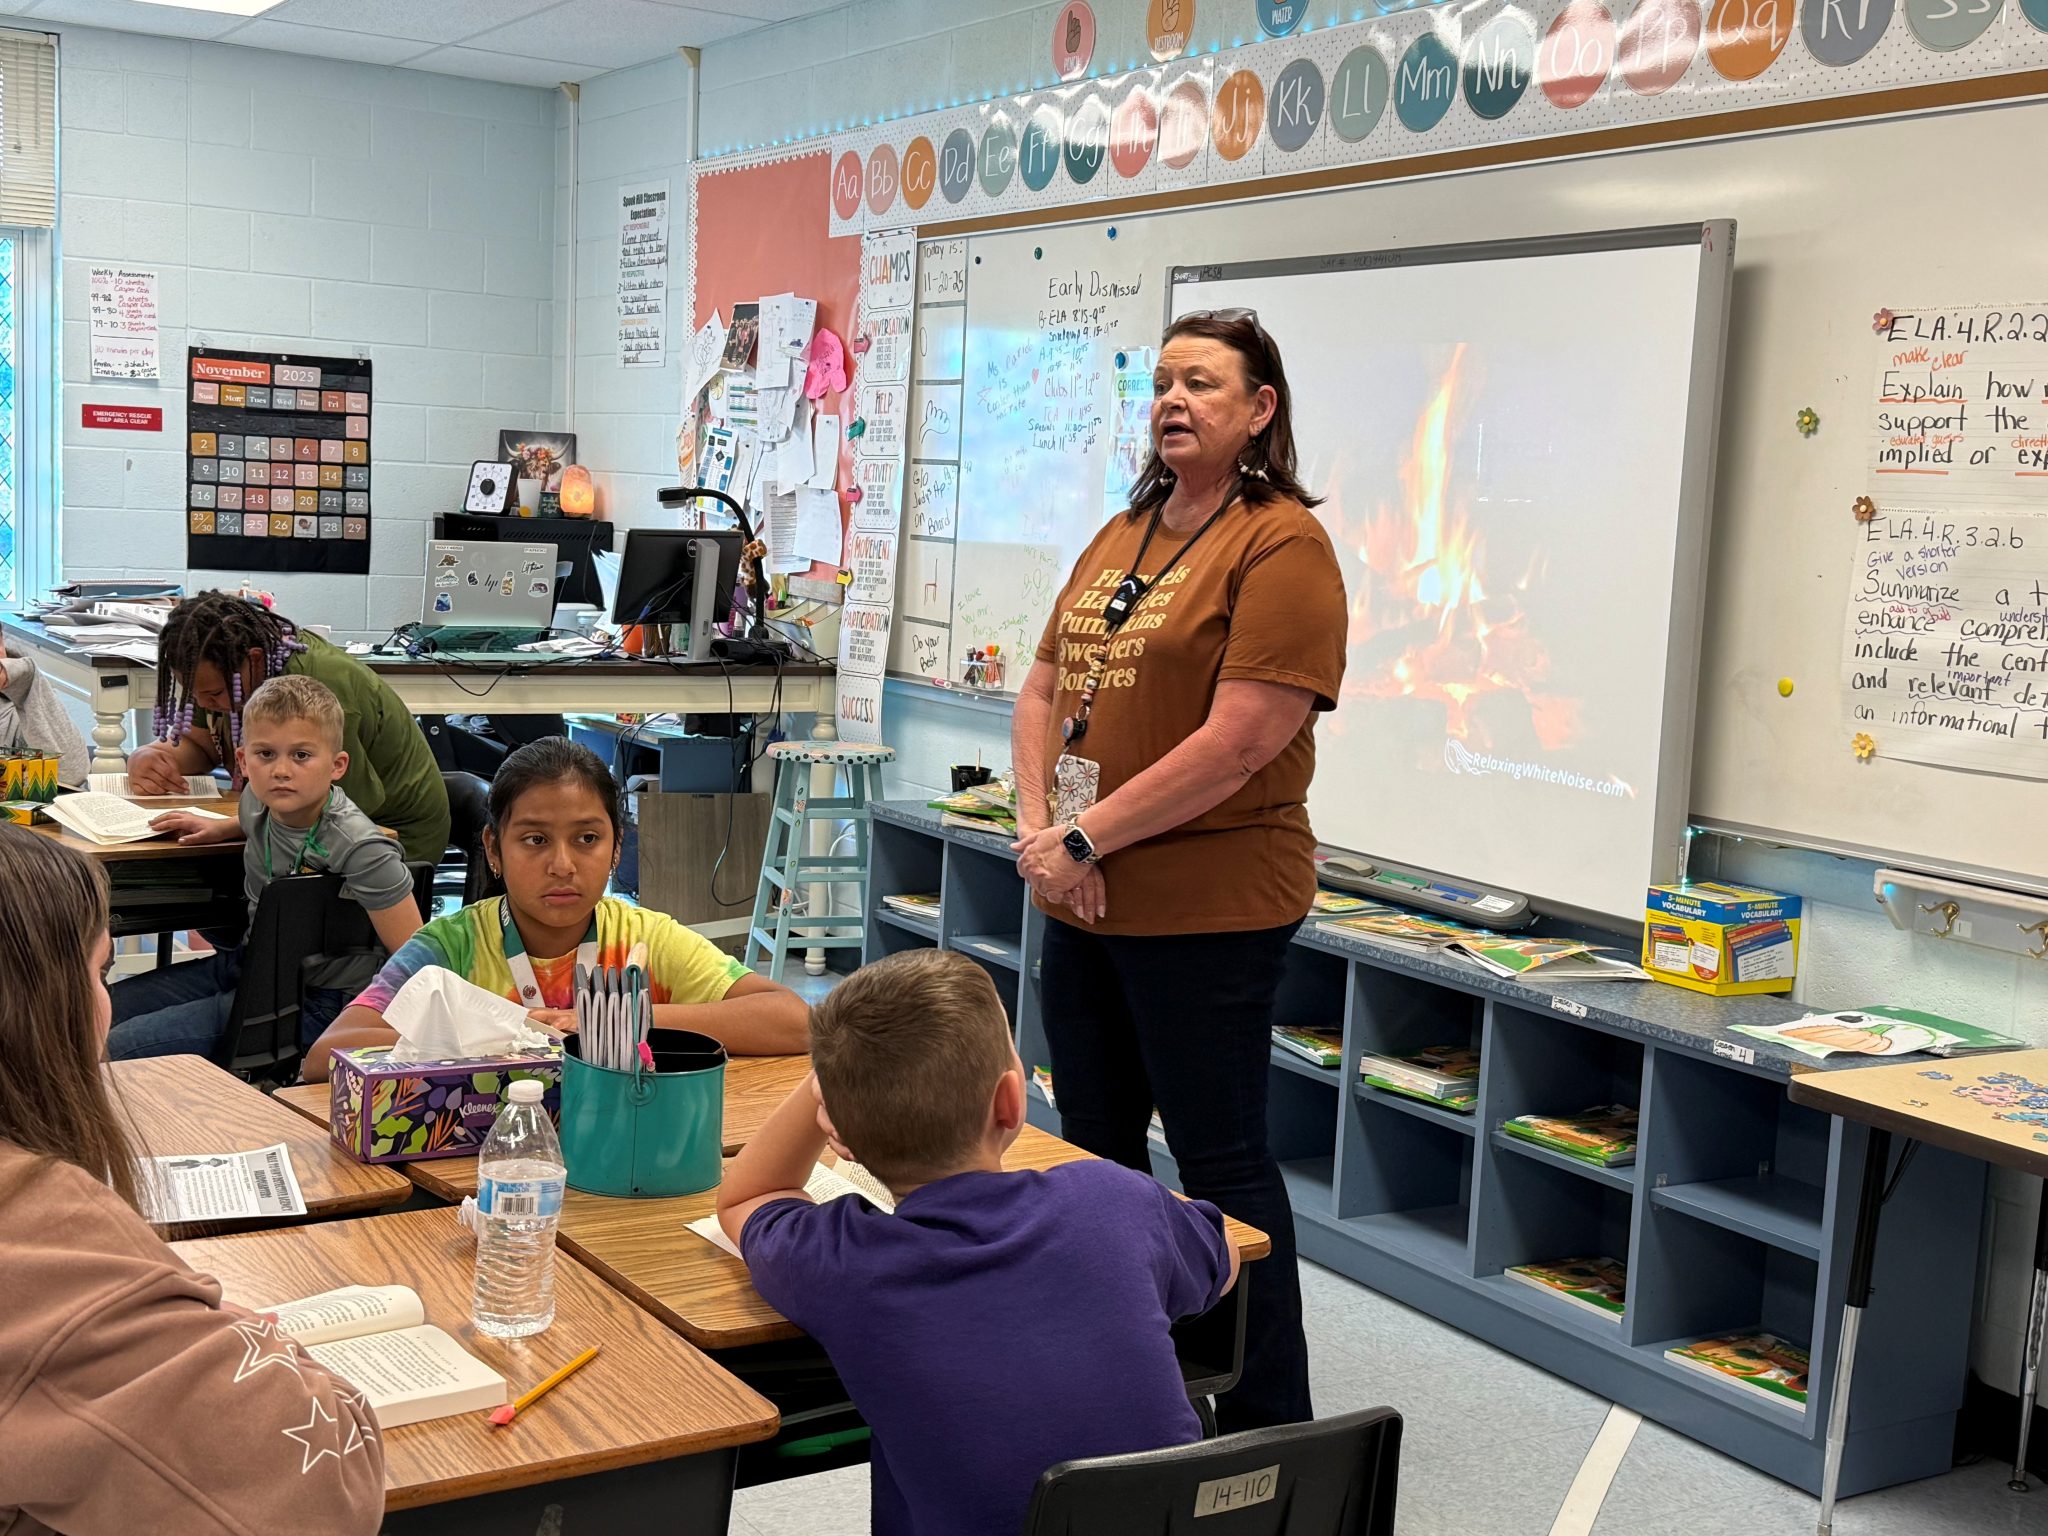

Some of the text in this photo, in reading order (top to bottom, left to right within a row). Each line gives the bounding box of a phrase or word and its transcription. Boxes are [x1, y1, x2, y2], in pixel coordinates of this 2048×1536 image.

[1272, 7, 1292, 25] WATER
[1154, 32, 1184, 52] RESTROOM
[836, 167, 859, 200] Aa
[871, 160, 894, 199] Bb
[906, 152, 931, 193] Cc
[944, 144, 969, 185] Dd
[985, 136, 1010, 177] Ee
[1028, 128, 1052, 174] Ff
[1069, 117, 1101, 167] Gg
[1223, 88, 1251, 143] Jj
[1277, 76, 1315, 128] Kk
[1343, 63, 1371, 119] Ll
[1400, 56, 1450, 104] Mm
[1476, 35, 1521, 95] Nn
[1551, 24, 1601, 79] Oo
[1636, 7, 1688, 74] Pp
[1718, 0, 1783, 52] Qq
[644, 192, 665, 203] Classroom
[631, 208, 656, 220] Expectations
[920, 241, 944, 260] Today
[92, 268, 113, 278] Weekly
[869, 250, 911, 285] CHAMPS
[1049, 270, 1082, 302] Early
[866, 317, 909, 338] CONVERSATION
[1893, 346, 1969, 372] make clear
[196, 363, 314, 382] November 2025
[1882, 370, 2034, 403] Explain how
[250, 396, 266, 404] Tues
[300, 399, 316, 407] Thur
[327, 400, 338, 408] Fri
[875, 391, 893, 414] HELP
[355, 424, 359, 432] 1
[1985, 405, 2030, 433] the
[201, 439, 359, 456] 2 3 4 5 6 7 8
[1032, 433, 1056, 451] Lunch
[1890, 433, 1927, 447] educated
[1879, 439, 1954, 470] implied
[1969, 447, 1997, 465] or
[202, 465, 363, 482] 9 10 11 12 13 14 15
[864, 463, 894, 483] ACTIVITY
[198, 491, 364, 507] 16 17 18 19 20 21 22
[250, 520, 263, 529] 25
[275, 520, 288, 530] 26
[324, 522, 337, 532] 28
[348, 523, 361, 533] 29
[928, 507, 951, 535] Board
[854, 536, 892, 560] MOVEMENT
[1867, 544, 1961, 568] Give a shorter
[1862, 569, 2010, 606] Summarize a
[843, 610, 890, 632] PARTICIPATION
[1058, 612, 1166, 640] Pumkins
[1857, 610, 1935, 632] enhance
[1059, 637, 1145, 662] Sweters
[1855, 635, 1918, 661] include
[1941, 642, 1980, 668] the
[919, 655, 938, 674] Best
[1057, 667, 1137, 690] Bonires
[1851, 667, 1888, 690] and
[1909, 672, 1997, 701] relevant
[1947, 670, 2012, 687] important
[841, 694, 874, 724] SUCCESS
[1854, 700, 2018, 738] an informational
[1472, 751, 1625, 797] RelaxingWhiteNoise.com
[1662, 901, 1707, 917] VOCABULARY
[1668, 895, 1702, 907] 5-MINUTE
[1747, 901, 1778, 910] 5-MINUTE
[1741, 909, 1783, 919] VOCABULARY
[1739, 1049, 1746, 1062] 4
[459, 1102, 500, 1118] Kleenex
[1213, 1473, 1270, 1509] 14-110
